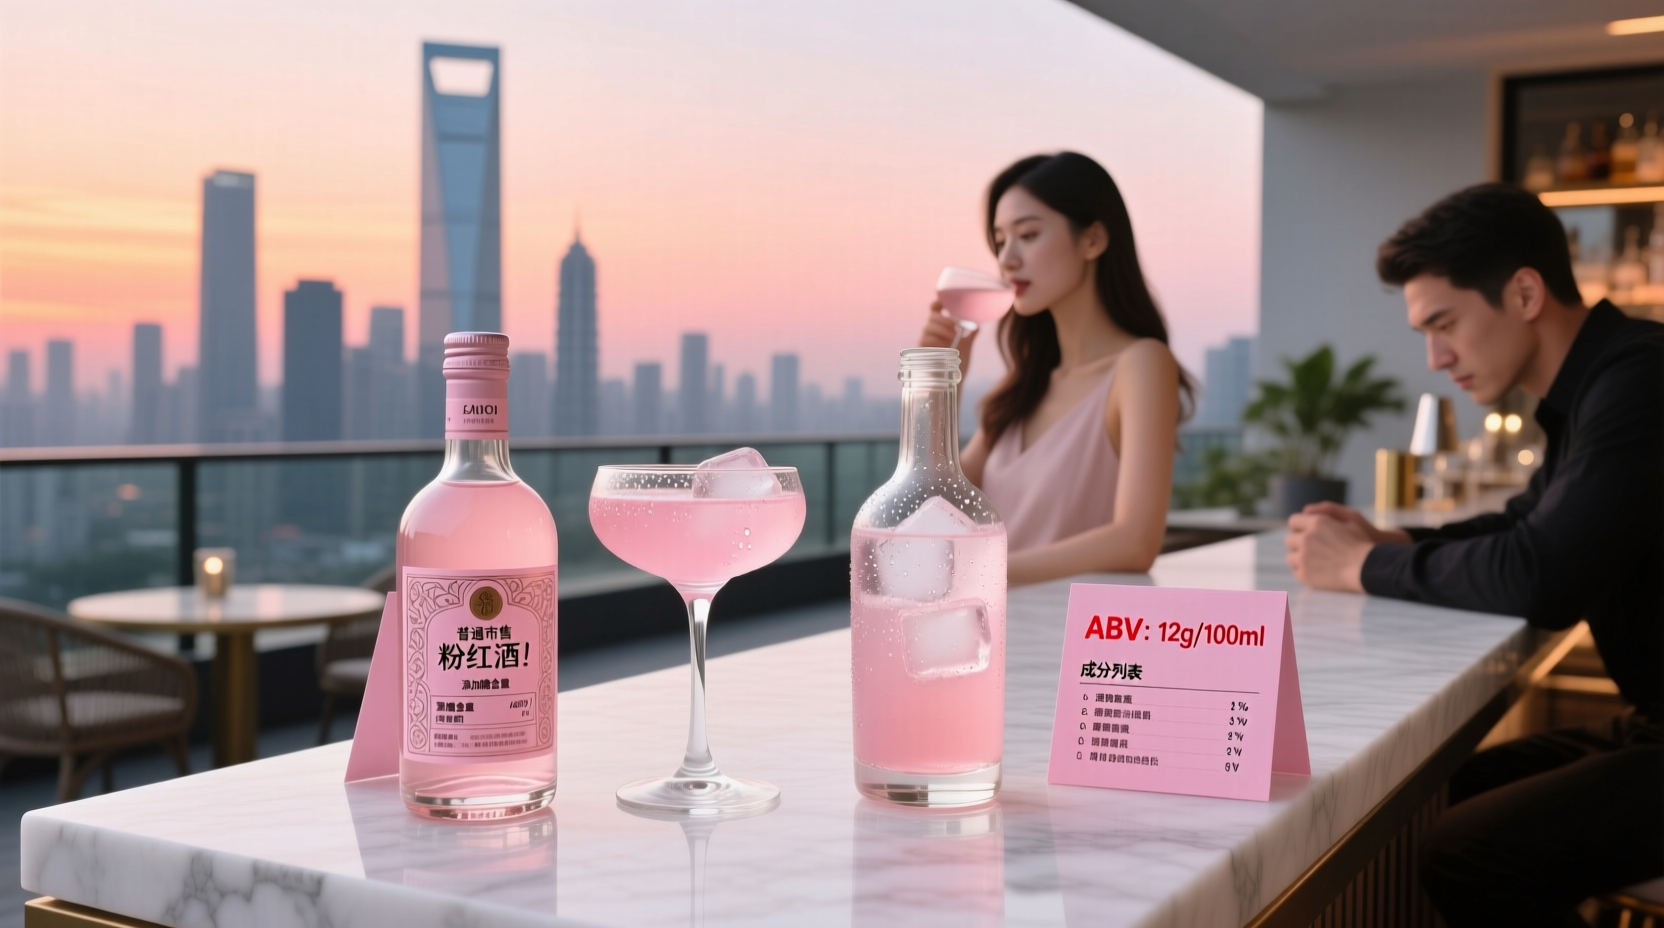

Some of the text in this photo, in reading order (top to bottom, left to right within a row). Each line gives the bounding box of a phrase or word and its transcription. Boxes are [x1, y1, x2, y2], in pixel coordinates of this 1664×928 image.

[1084, 614, 1266, 649] ABV: 12g/100ml
[1080, 659, 1143, 681] 成分列表
